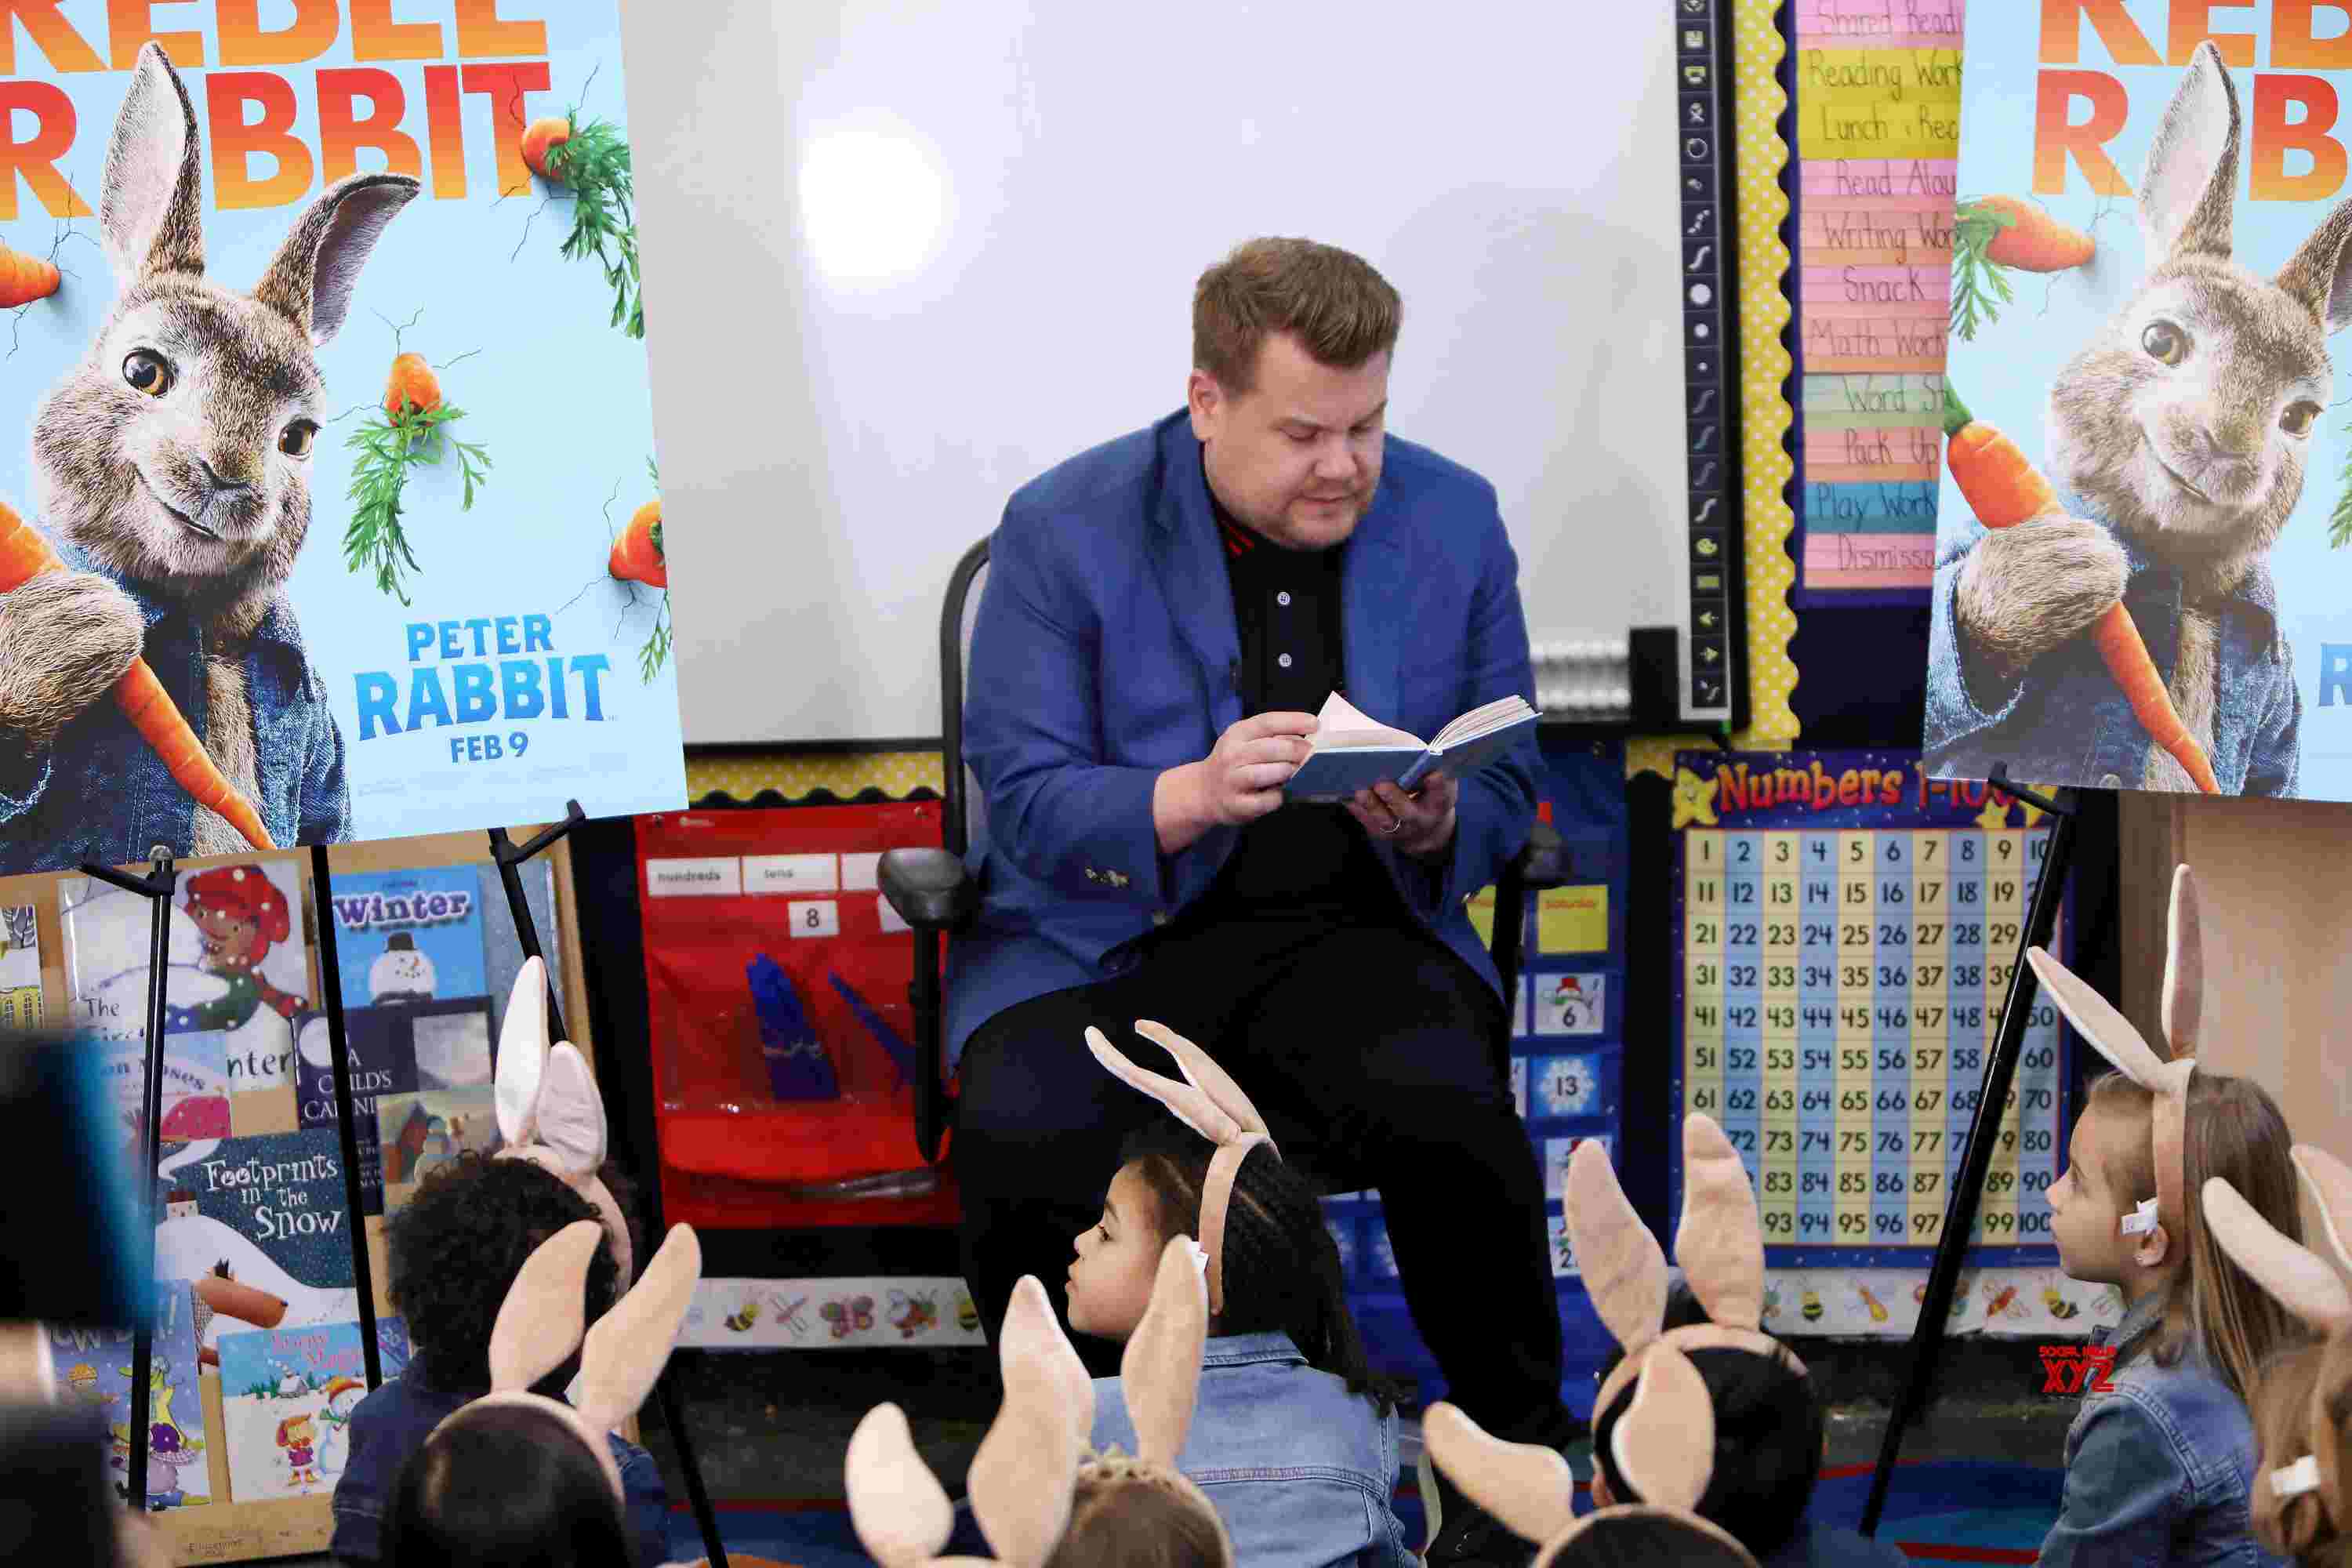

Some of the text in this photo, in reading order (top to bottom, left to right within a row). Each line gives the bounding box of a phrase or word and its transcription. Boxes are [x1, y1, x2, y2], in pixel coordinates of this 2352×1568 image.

[1806, 49, 1902, 102] Reading
[1820, 104, 1889, 141] Lunch
[0, 62, 551, 220] RBBIT
[1835, 158, 1893, 195] Read
[1820, 211, 1907, 264] Writing
[1806, 318, 1882, 357] Math
[1842, 375, 1907, 413] Word
[1844, 427, 1939, 477] Pack Up
[1815, 481, 1870, 532] Play
[406, 614, 554, 662] PETER
[353, 653, 611, 742] RABBIT
[450, 731, 528, 764] FEB 9
[1717, 760, 1904, 812] Numbers
[1703, 840, 1710, 860] 1
[1737, 840, 1751, 862] 2
[1776, 840, 1789, 863] 3
[1812, 841, 1826, 862] 4
[1850, 841, 1864, 862] 5
[1886, 840, 1901, 862] 6
[1924, 840, 1938, 862] 7
[1961, 840, 1975, 862] 8
[1997, 840, 2012, 860] 9
[1699, 881, 1714, 902] 11
[1733, 882, 1753, 904] 12
[1772, 883, 1792, 904] 13
[1808, 884, 1829, 904] 14
[1846, 883, 1867, 904] 15
[1883, 882, 1904, 904] 16
[1920, 882, 1941, 903] 17
[1958, 882, 1978, 903] 18
[1994, 881, 2014, 902] 19
[331, 892, 471, 927] Winter
[806, 908, 820, 927] 8
[1695, 923, 2018, 946] 21 22 23 24 25 26 27 28 29
[1695, 964, 1716, 985] 31
[1729, 965, 1757, 987] 32
[1768, 965, 1795, 987] 33
[1804, 966, 1832, 987] 34
[1842, 966, 1870, 987] 35
[1878, 965, 1907, 987] 36
[1916, 965, 1944, 987] 37
[1954, 965, 1981, 987] 38
[86, 997, 119, 1018] The
[1562, 1005, 1576, 1028] 6
[1694, 1006, 1716, 1026] 41
[1729, 1007, 1757, 1028] 42
[1767, 1007, 1795, 1029] 43
[1802, 1008, 1832, 1029] 44
[1841, 1007, 1870, 1029] 45
[1878, 1008, 1907, 1029] 46
[1915, 1007, 1944, 1028] 47
[1953, 1007, 1981, 1029] 48
[227, 1051, 292, 1078] nter
[347, 1047, 361, 1067] A
[1695, 1047, 2054, 1071] 51 52 53 54 55 56 57 58 60
[318, 1069, 392, 1094] CILD'S
[1555, 1075, 1578, 1096] 13
[1693, 1088, 1715, 1109] 61
[1727, 1089, 1755, 1110] 62
[1765, 1090, 1795, 1111] 63
[1802, 1091, 1831, 1111] 64
[1840, 1091, 1868, 1111] 65
[1875, 1091, 1907, 1111] 66
[1915, 1091, 1942, 1111] 67
[1951, 1090, 1981, 1111] 68
[2025, 1087, 2052, 1110] 70
[1766, 1131, 1793, 1152] 73
[1802, 1131, 1830, 1152] 74
[1840, 1131, 1867, 1153] 75
[1878, 1131, 1904, 1152] 76
[1914, 1131, 1943, 1152] 77
[2023, 1130, 2052, 1151] 80
[200, 1153, 339, 1192] Footprints
[1764, 1172, 1793, 1192] 83
[1801, 1172, 1829, 1194] 84
[1838, 1172, 1867, 1193] 85
[1875, 1172, 1904, 1193] 86
[1913, 1172, 1941, 1194] 87
[1986, 1171, 2014, 1192] 89
[2022, 1171, 2052, 1192] 90
[240, 1186, 309, 1208] in the
[254, 1205, 343, 1243] Snow
[1764, 1212, 1792, 1234] 93
[1799, 1213, 1830, 1233] 94
[1838, 1213, 1867, 1234] 95
[1875, 1214, 1904, 1235] 96
[1912, 1213, 1940, 1234] 97
[1984, 1212, 2014, 1233] 99
